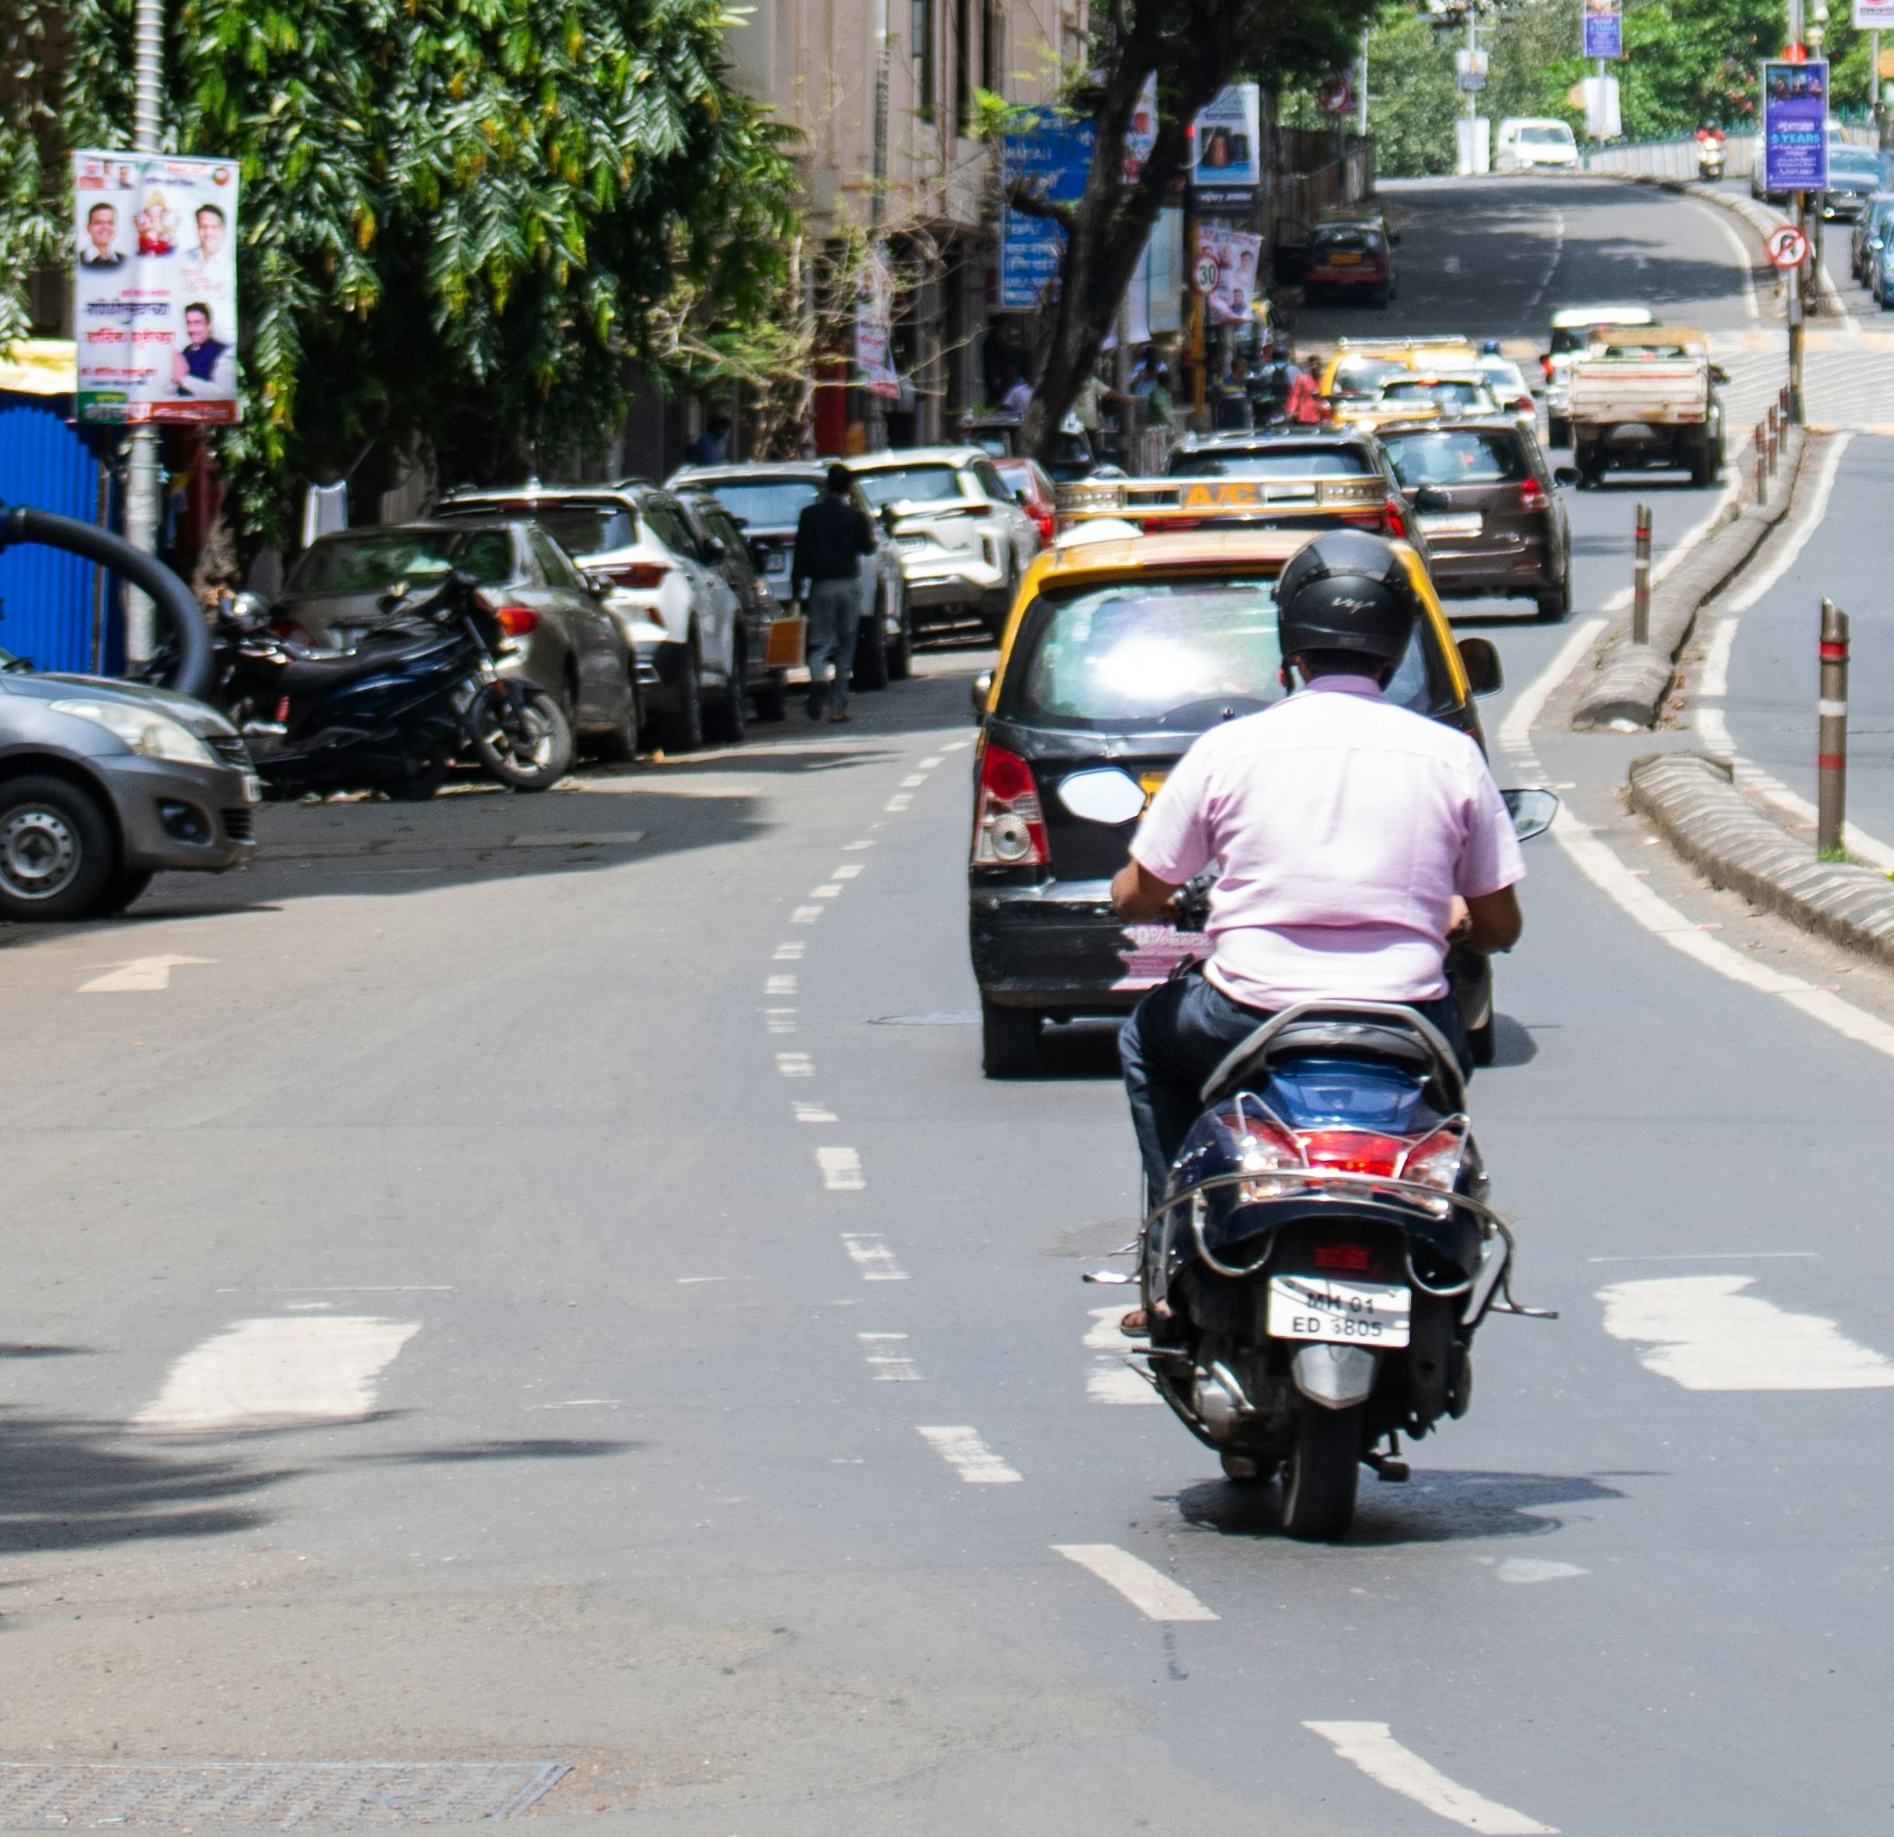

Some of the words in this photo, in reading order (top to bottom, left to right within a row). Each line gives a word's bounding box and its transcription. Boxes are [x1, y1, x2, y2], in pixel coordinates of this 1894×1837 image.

[1200, 265, 1217, 285] 30
[1185, 483, 1258, 506] A/C
[1307, 1292, 1341, 1311] MH
[1350, 1296, 1374, 1314] 01
[1292, 1316, 1321, 1333] ED
